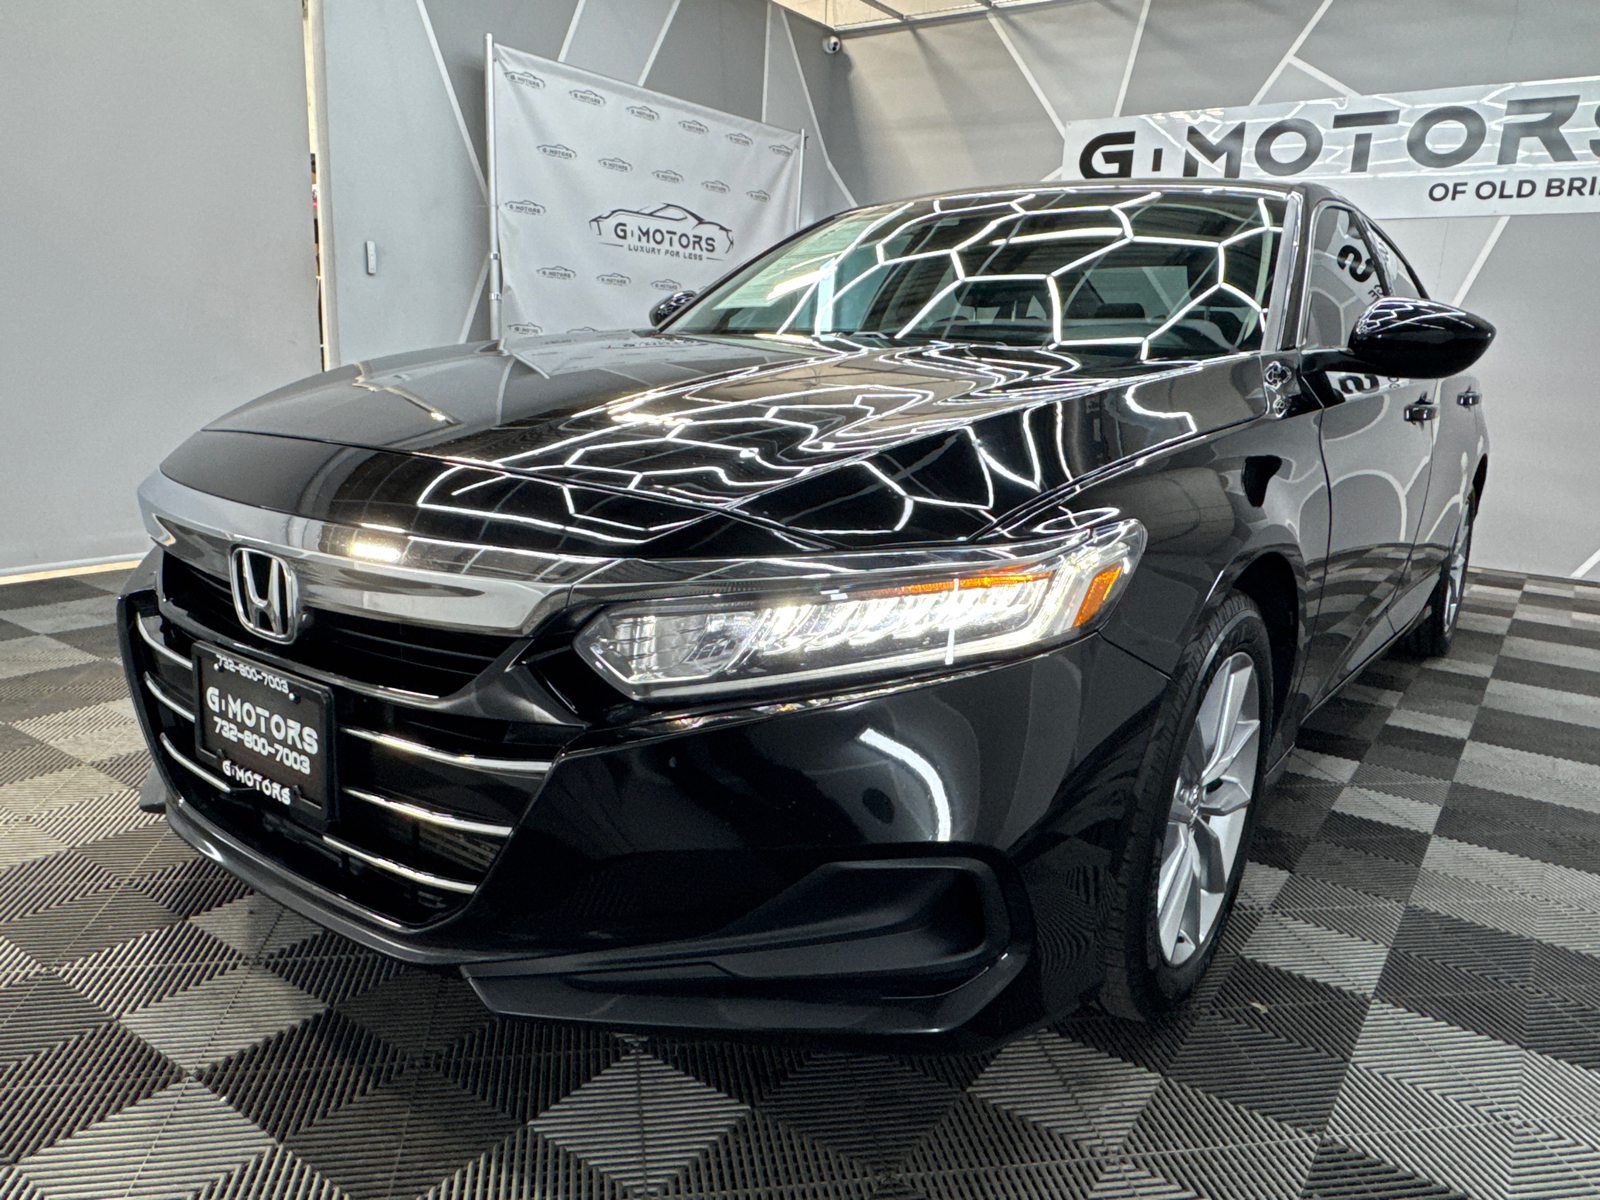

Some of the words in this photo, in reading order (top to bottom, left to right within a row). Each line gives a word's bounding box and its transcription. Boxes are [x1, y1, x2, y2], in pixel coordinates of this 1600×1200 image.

[1183, 94, 1600, 179] MOTOR
[1428, 181, 1468, 202] OF
[1475, 179, 1537, 200] OLD
[1545, 176, 1600, 197] BRI
[628, 243, 662, 256] LUXURY
[664, 248, 681, 259] FOR
[683, 251, 703, 261] LESS
[637, 225, 716, 253] MOTORS
[213, 716, 311, 775] 732-800-7003
